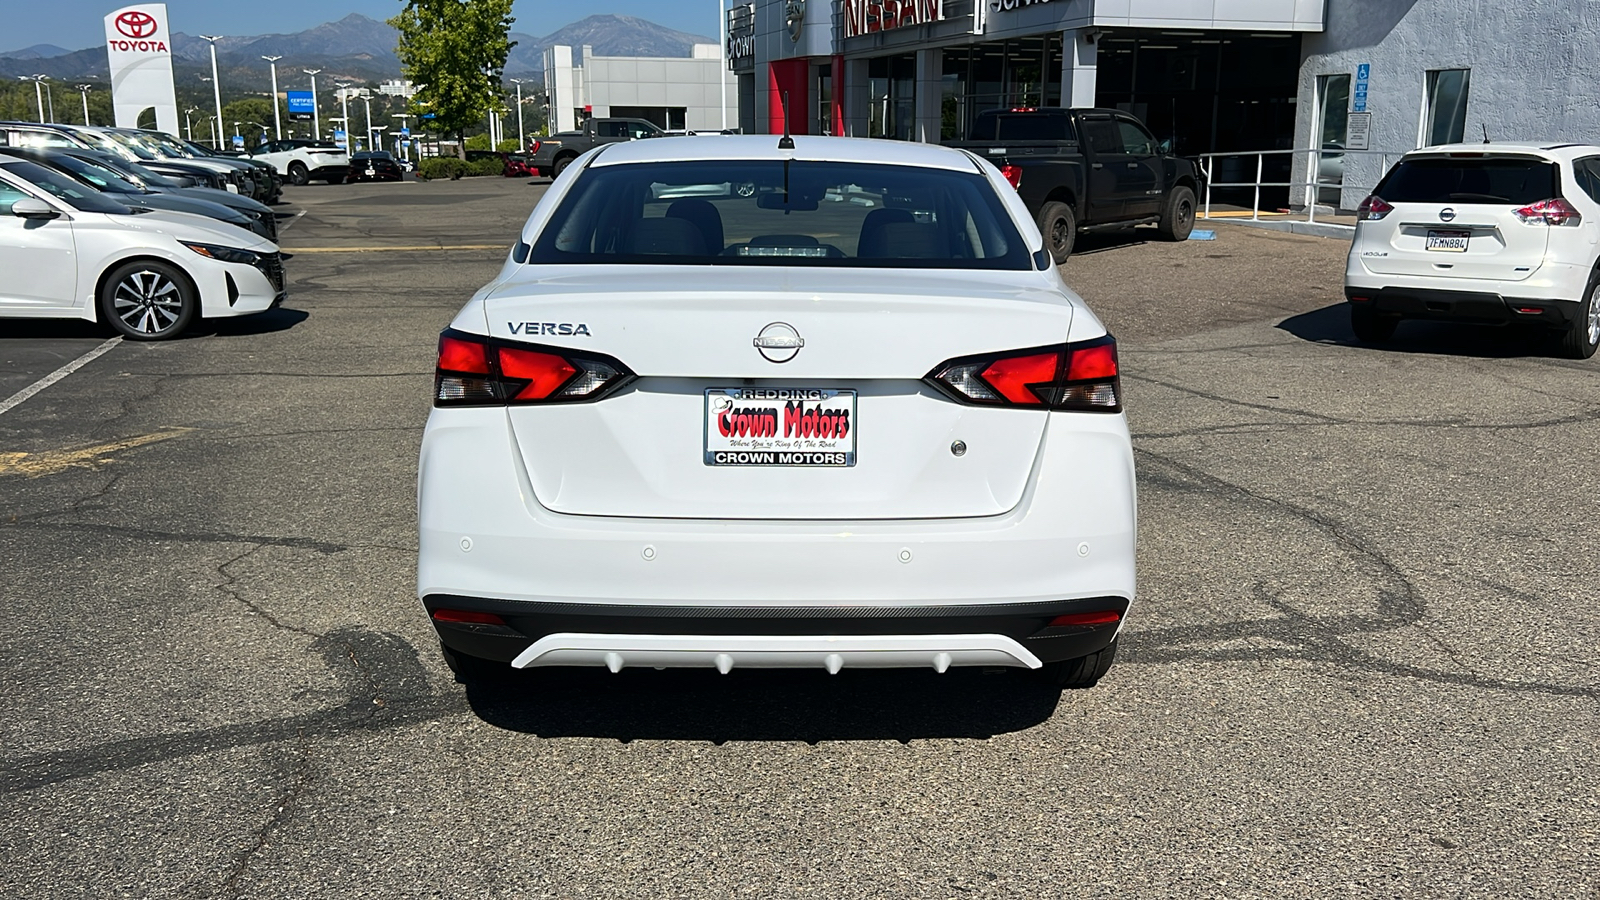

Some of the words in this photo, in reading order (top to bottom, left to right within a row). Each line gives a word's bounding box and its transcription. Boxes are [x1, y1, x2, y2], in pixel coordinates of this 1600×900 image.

[109, 40, 168, 52] TOYOTA
[1429, 237, 1465, 249] 7FMN884
[507, 322, 592, 337] VERSA
[754, 337, 804, 347] NISSAN
[742, 389, 821, 400] REDDING
[718, 406, 777, 438] Crown
[784, 401, 849, 439] Motors
[751, 440, 773, 449] You're
[774, 440, 791, 449] King
[793, 440, 803, 449] Of
[818, 440, 837, 448] Road
[715, 452, 776, 464] CROWN
[778, 452, 845, 464] MOTORS
